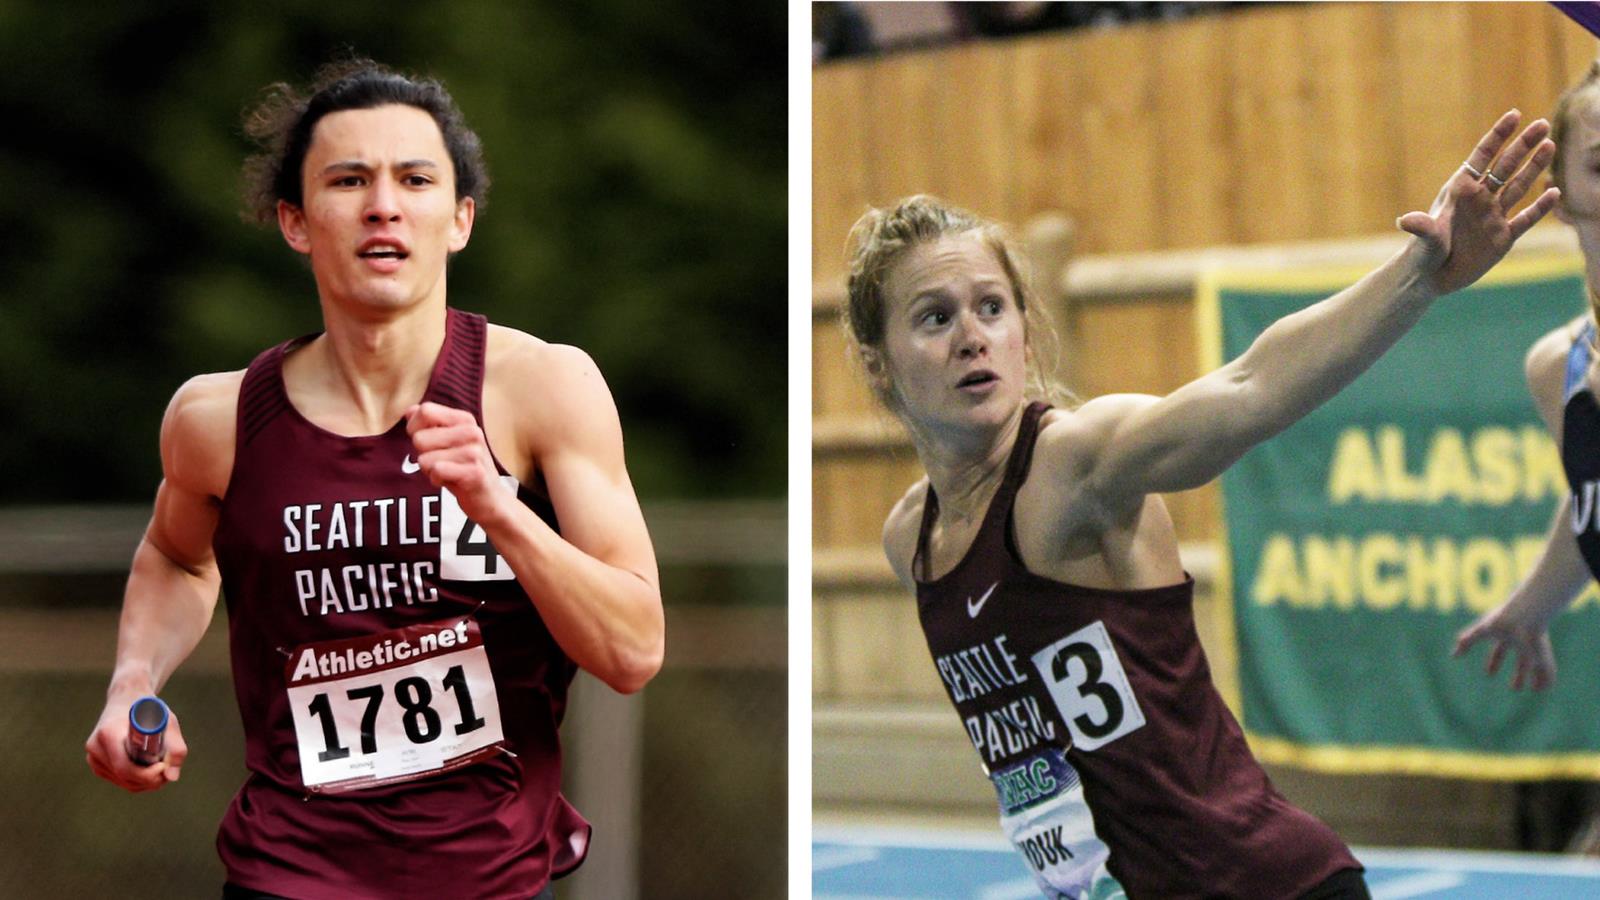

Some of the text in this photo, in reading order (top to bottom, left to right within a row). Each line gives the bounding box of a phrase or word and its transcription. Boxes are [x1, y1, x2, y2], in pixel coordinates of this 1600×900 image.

[284, 496, 439, 552] SEATTLE
[456, 515, 500, 574] 4
[295, 562, 438, 615] PACIFIC
[291, 621, 468, 681] Athletic.net
[937, 635, 1028, 703] SEATTLE
[308, 665, 486, 762] 1781
[1052, 642, 1124, 739] 3
